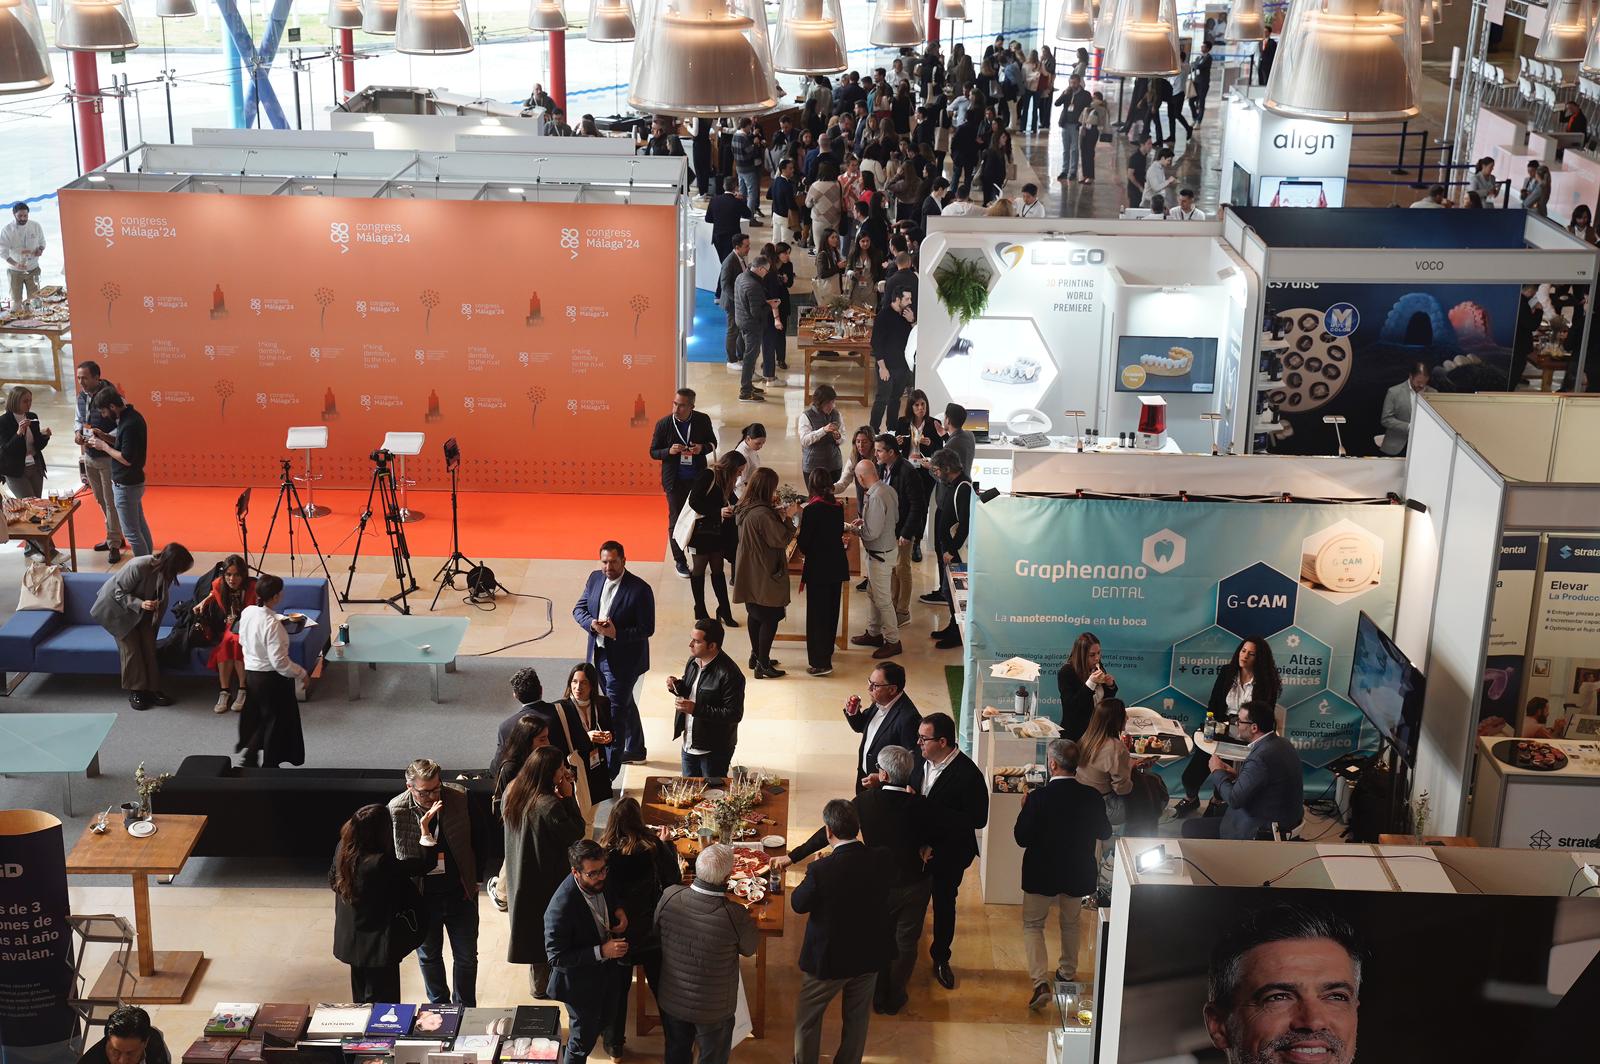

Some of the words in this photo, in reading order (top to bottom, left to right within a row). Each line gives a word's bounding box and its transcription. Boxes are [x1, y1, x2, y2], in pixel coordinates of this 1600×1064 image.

[1274, 129, 1334, 155] align
[120, 217, 168, 227] congress
[356, 223, 402, 233] congress
[586, 229, 631, 239] congress
[1030, 248, 1106, 265] GO
[1415, 260, 1444, 271] VOCO
[1058, 279, 1094, 288] PRINTING
[1066, 291, 1093, 300] WORLD
[1053, 303, 1093, 312] PREMIERE
[983, 467, 1012, 475] BEG
[1015, 559, 1147, 583] Graphenano
[1551, 580, 1589, 591] Elevar
[1092, 586, 1145, 599] DENTAL
[1227, 594, 1287, 609] G-CAM
[995, 611, 1007, 622] La
[1009, 613, 1091, 626] nanotecnología
[1093, 617, 1106, 625] en
[1109, 616, 1120, 626] tu
[1122, 616, 1147, 626] boca
[1289, 654, 1323, 666] Altas
[9, 904, 27, 915] de
[31, 902, 41, 912] 3
[34, 916, 52, 928] de
[15, 934, 28, 945] al
[32, 931, 59, 944] año
[2, 949, 54, 961] avalan.
